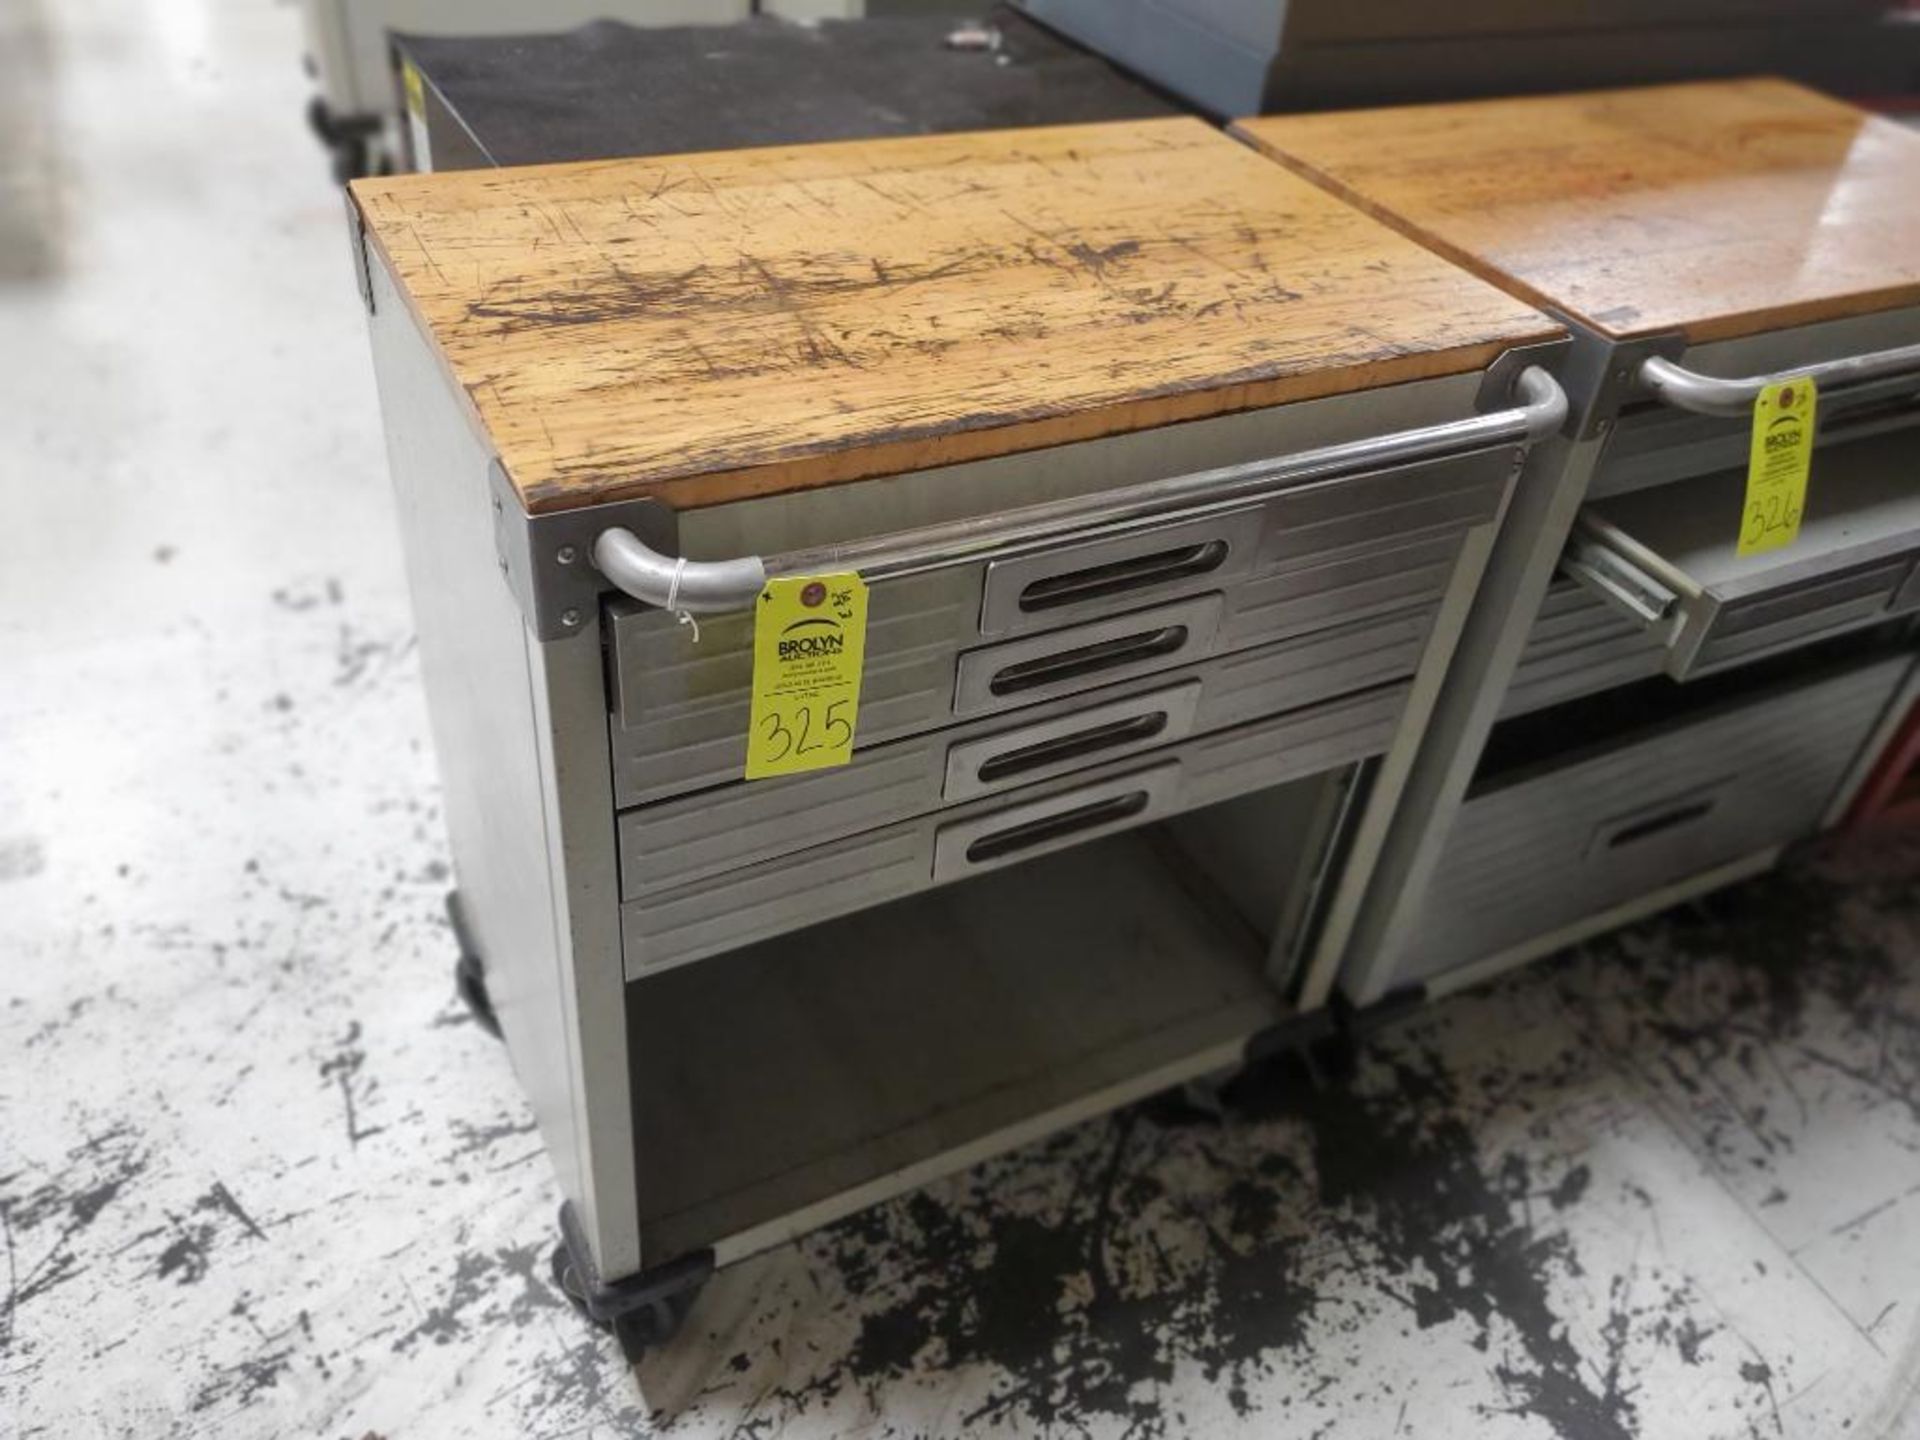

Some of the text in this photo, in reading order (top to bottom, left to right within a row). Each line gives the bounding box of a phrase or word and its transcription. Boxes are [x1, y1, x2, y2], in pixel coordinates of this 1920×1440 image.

[1746, 492, 1799, 545] 326
[779, 634, 844, 656] BROLYN
[779, 648, 843, 662] AUCTIONS
[760, 700, 851, 763] 325
